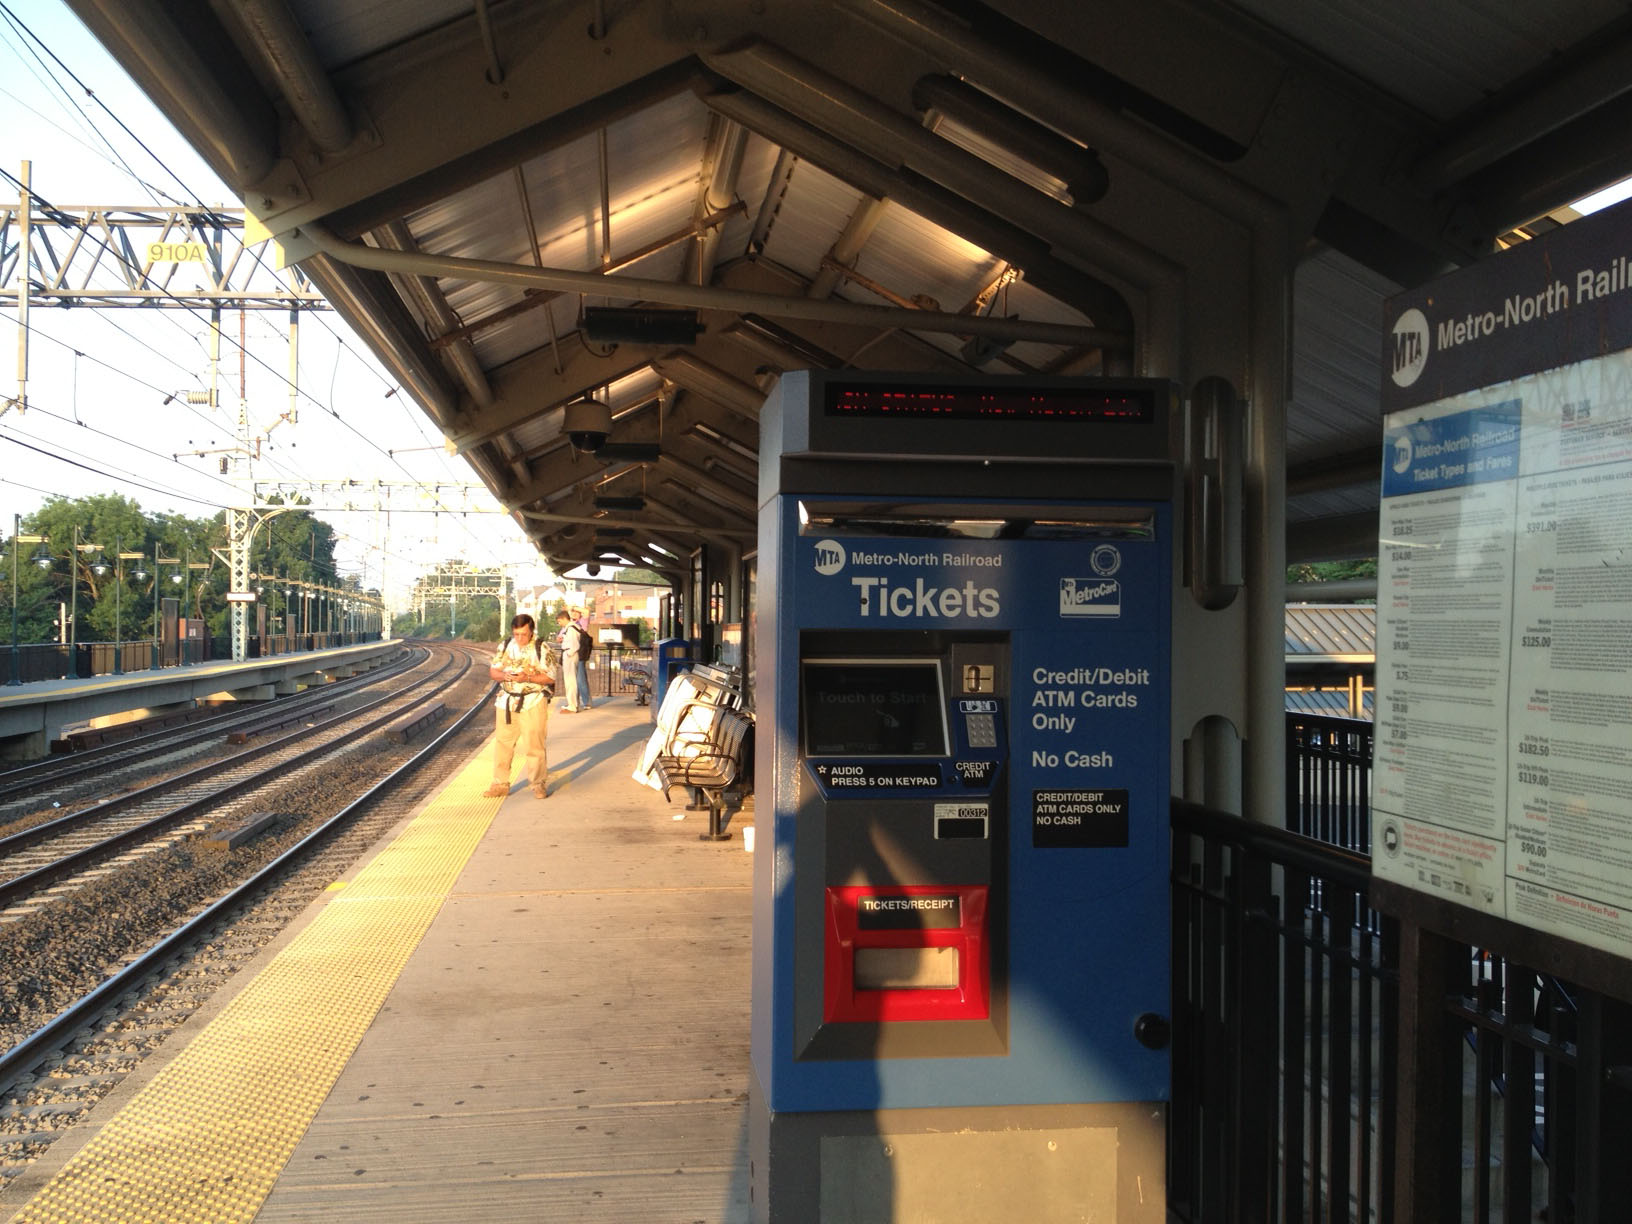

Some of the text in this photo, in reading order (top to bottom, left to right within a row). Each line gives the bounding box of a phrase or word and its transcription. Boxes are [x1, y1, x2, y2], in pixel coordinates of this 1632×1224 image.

[151, 244, 203, 261] 910A
[1438, 280, 1569, 351] Metro-North
[1415, 429, 1515, 458] Metro-North Railroad
[1413, 456, 1513, 481] Ticket Types and Fares
[852, 552, 1002, 567] Metro-North Railroad
[852, 577, 1000, 618] Tickets
[1033, 668, 1150, 685] Credit/Debit
[1032, 691, 1138, 708] ATM Cards
[1032, 713, 1076, 733] Only
[955, 762, 990, 771] CREDIT
[1032, 751, 1113, 768] No Cash
[831, 767, 864, 775] AUDIO
[964, 770, 984, 778] ATM
[831, 777, 937, 786] PRESS 5 ON KEYPAD
[1036, 793, 1104, 802] CREDIT/DEBIT
[959, 808, 986, 817] 00312
[1036, 804, 1121, 813] ATM CARDS ONLY
[1036, 816, 1081, 825] NO CASH
[864, 900, 954, 910] TICKETS/RECEIPT
